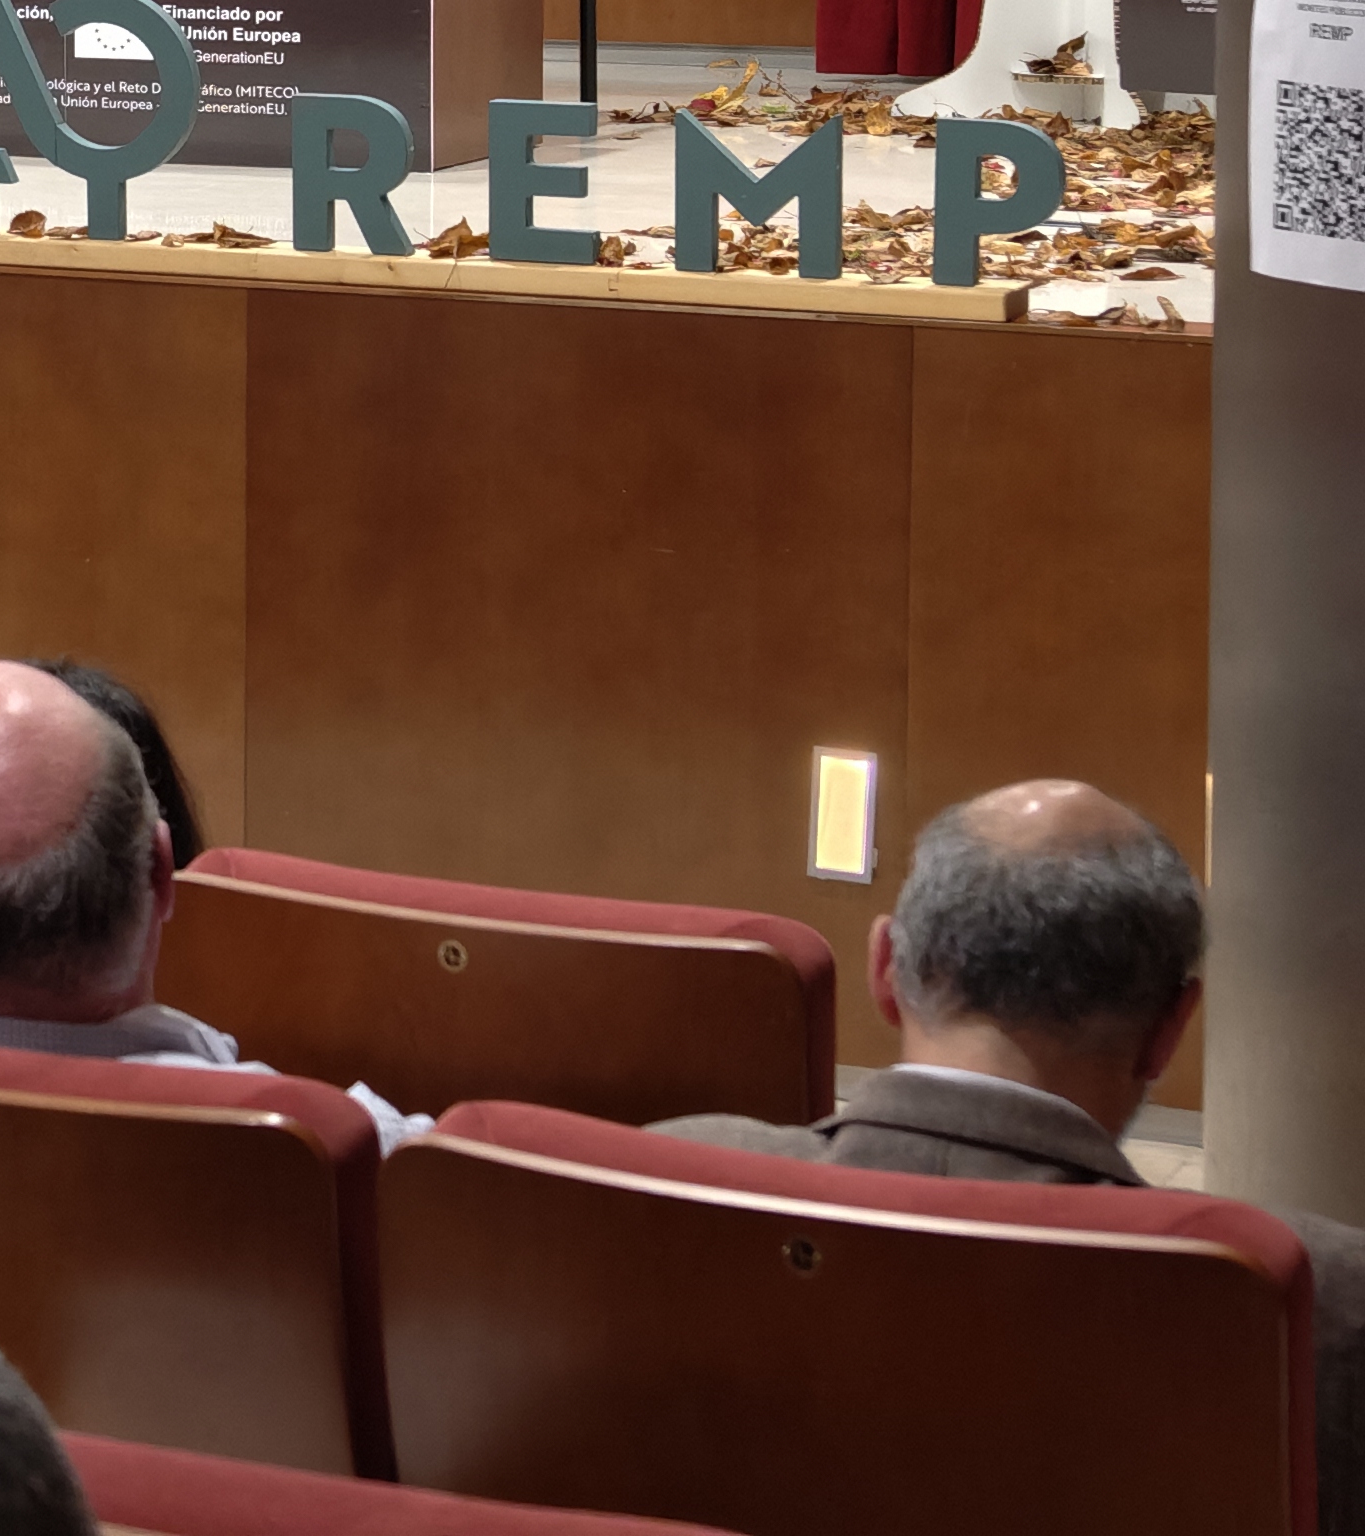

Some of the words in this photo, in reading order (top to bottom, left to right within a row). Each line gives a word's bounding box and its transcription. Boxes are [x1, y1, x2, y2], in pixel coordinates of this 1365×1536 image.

[255, 9, 284, 25] por
[232, 27, 301, 45] Europea
[1309, 22, 1355, 42] REMP
[93, 82, 101, 95] y
[104, 80, 116, 92] el
[119, 81, 149, 94] Reto
[61, 94, 98, 108] Unión
[101, 96, 154, 112] Europea
[291, 90, 1068, 287] REMP
